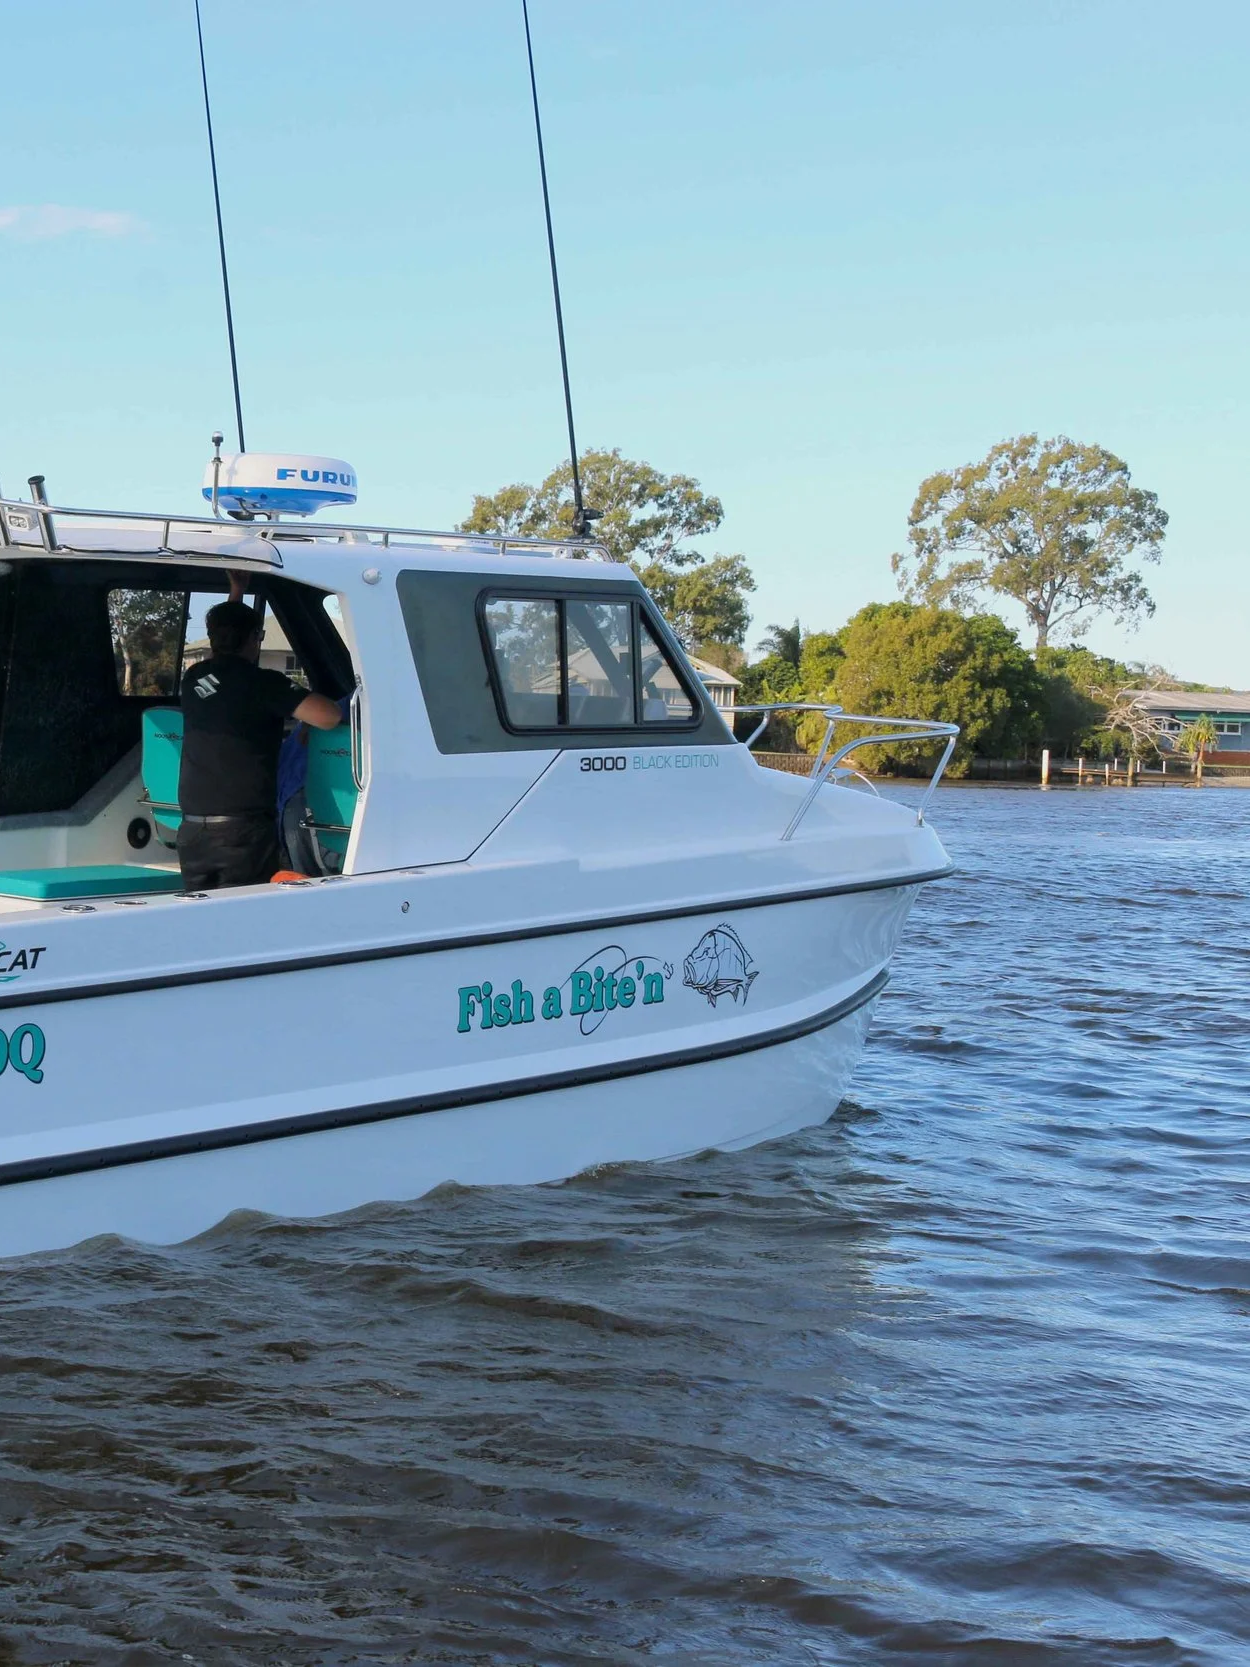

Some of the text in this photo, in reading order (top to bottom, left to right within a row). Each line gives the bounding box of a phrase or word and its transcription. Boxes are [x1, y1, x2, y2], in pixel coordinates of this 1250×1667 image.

[580, 754, 719, 772] 3000 BLACK EDITION
[457, 959, 665, 1033] Fish a Bite'n
